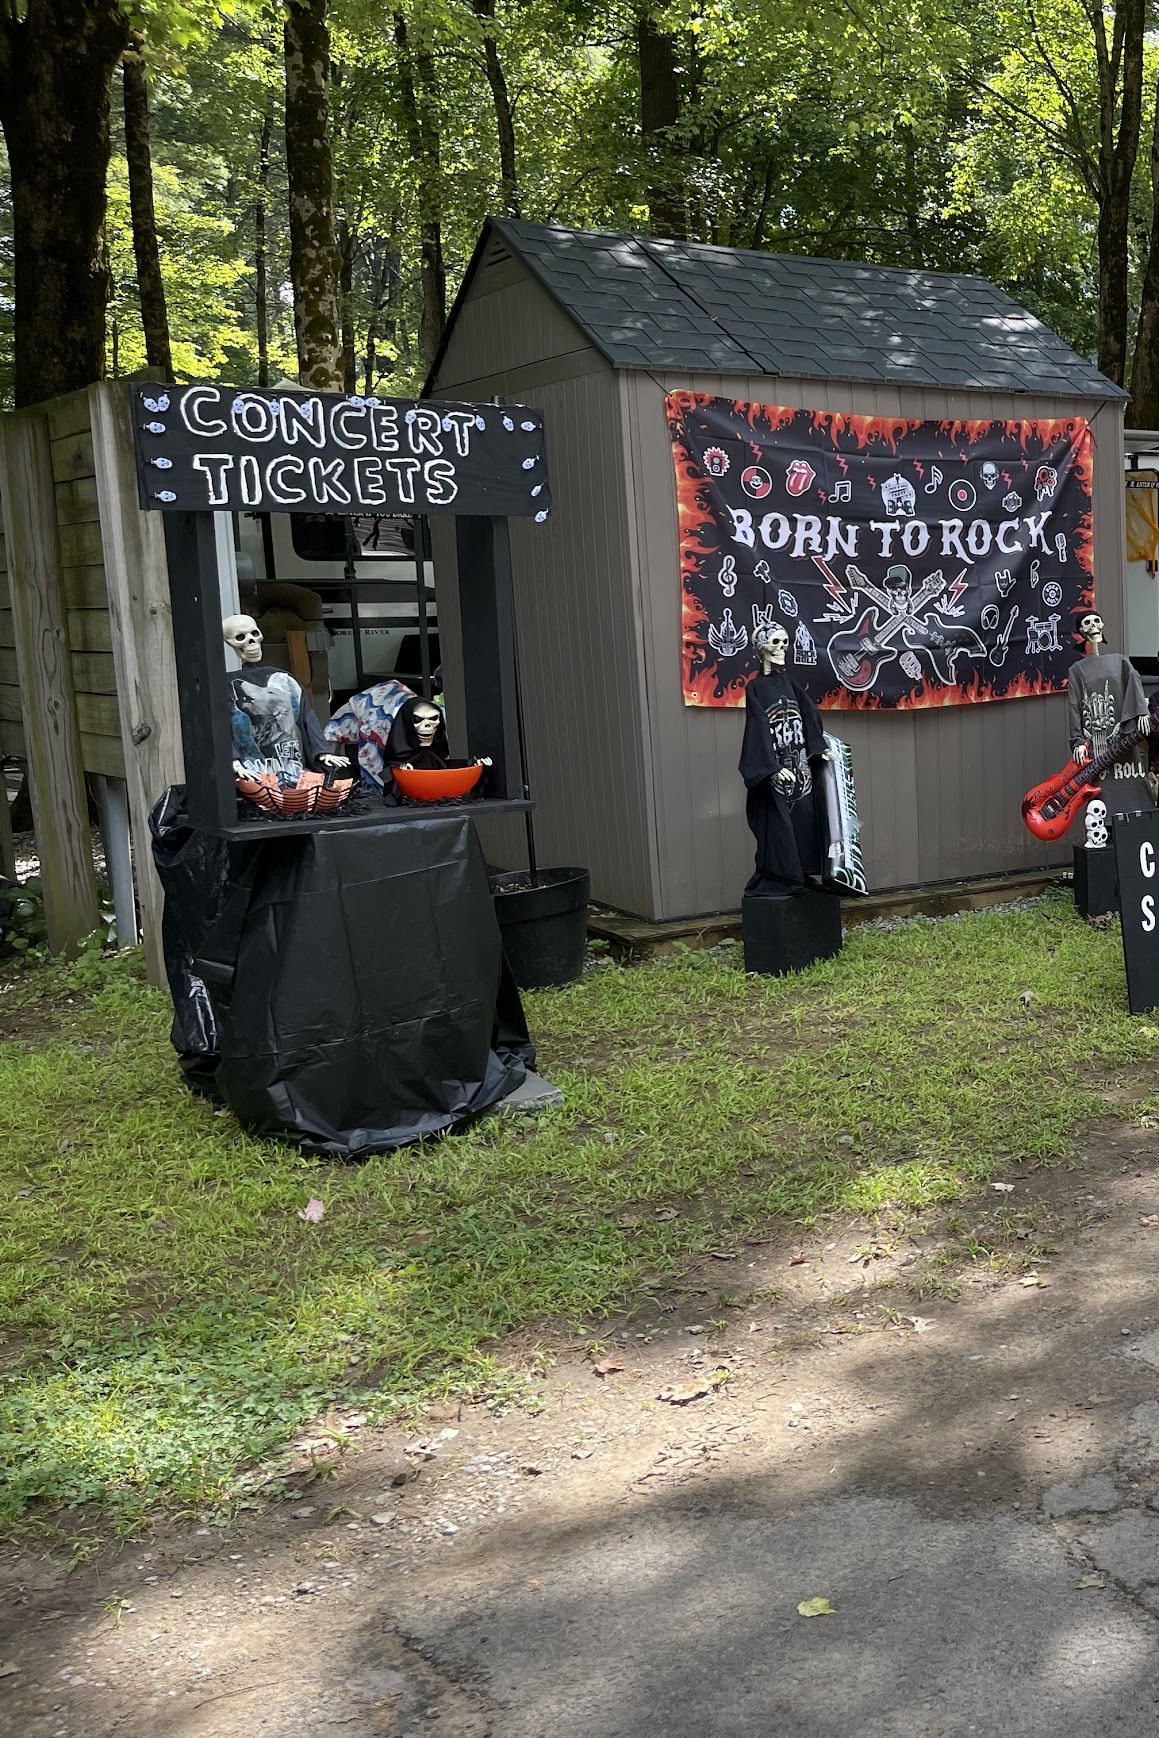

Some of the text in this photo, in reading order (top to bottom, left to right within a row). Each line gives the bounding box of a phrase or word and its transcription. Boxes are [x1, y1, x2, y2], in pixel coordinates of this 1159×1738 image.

[180, 386, 477, 457] CONCERT
[193, 454, 458, 505] TICKETS
[726, 504, 1054, 564] BORN TO ROCK
[1113, 761, 1146, 780] ROLL
